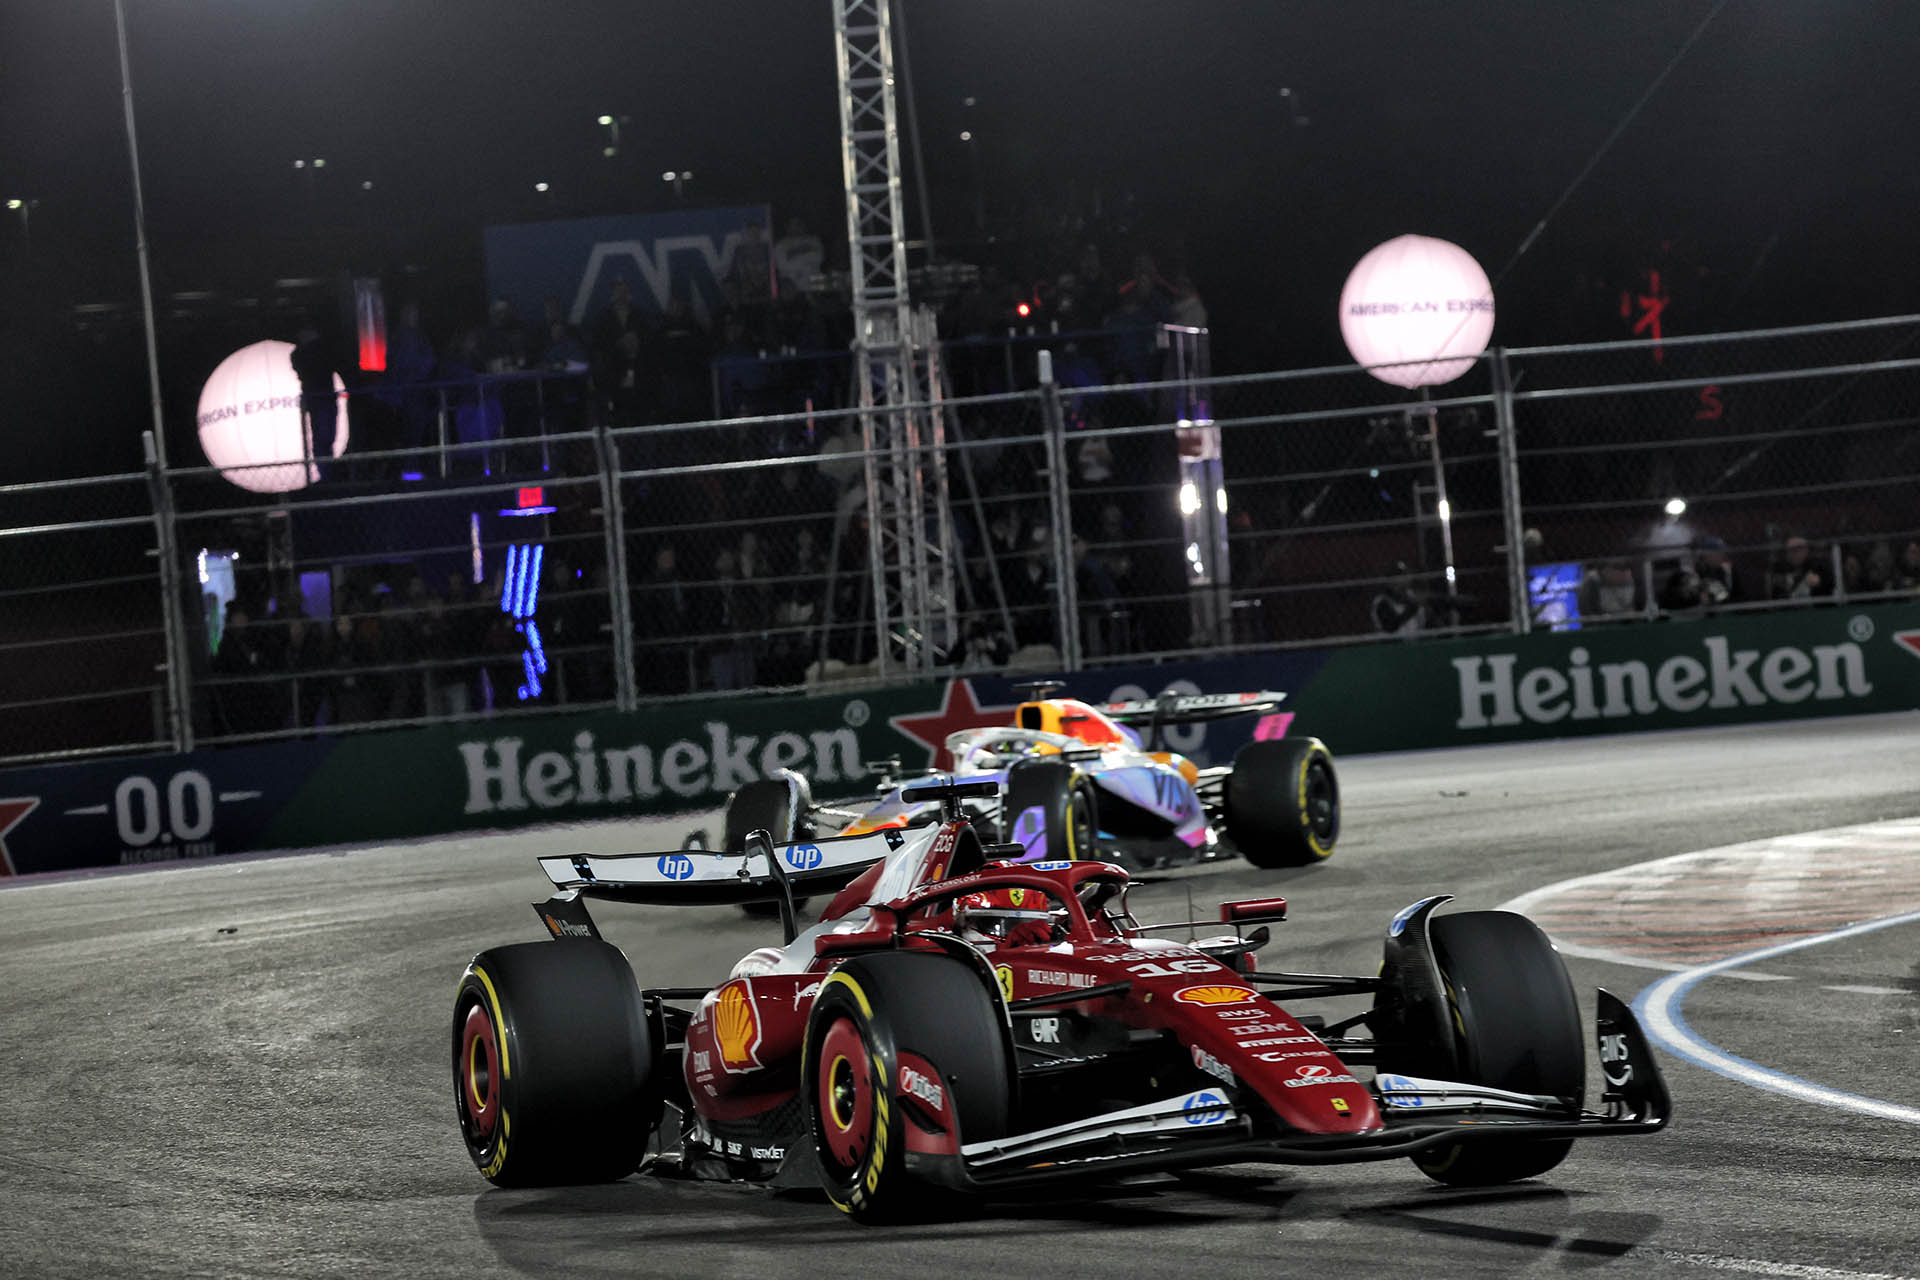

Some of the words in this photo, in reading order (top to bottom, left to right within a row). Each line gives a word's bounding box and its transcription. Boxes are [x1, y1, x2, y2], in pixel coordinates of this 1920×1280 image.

[199, 405, 238, 428] RICAN
[1452, 636, 1873, 729] Heineken
[460, 721, 867, 815] Heineken
[115, 770, 214, 847] 0.0
[663, 856, 688, 880] hp
[792, 845, 816, 869] hp
[1028, 969, 1067, 986] RICHARD
[1126, 960, 1223, 978] 16
[1216, 1008, 1266, 1018] aws
[1227, 1022, 1295, 1036] IBM
